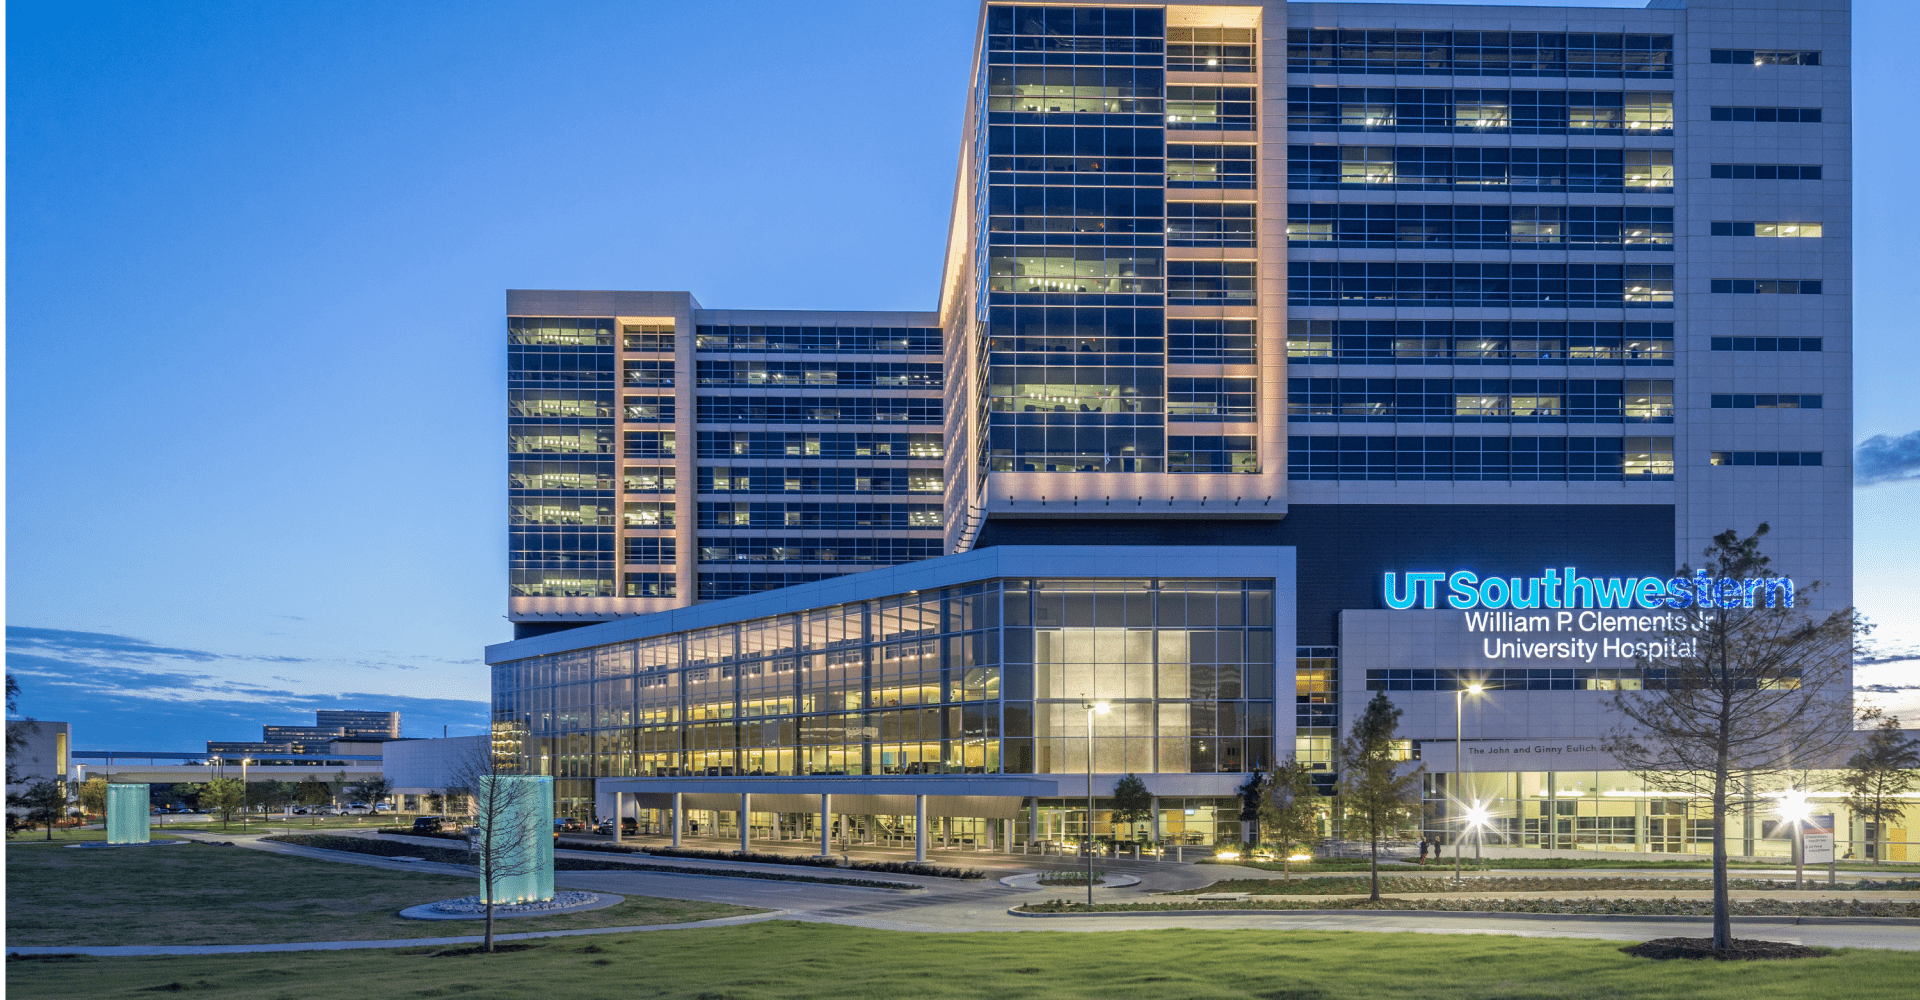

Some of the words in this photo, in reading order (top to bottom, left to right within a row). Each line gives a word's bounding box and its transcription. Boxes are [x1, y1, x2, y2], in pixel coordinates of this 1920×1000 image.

[1464, 611, 1551, 632] William
[1557, 611, 1573, 632] P.
[1577, 610, 1688, 632] Clements
[1483, 638, 1598, 663] University
[1603, 637, 1698, 662] Hospital
[1468, 747, 1485, 755] The
[1488, 746, 1510, 754] John
[1513, 745, 1531, 754] and
[1534, 745, 1563, 755] Ginny
[1566, 744, 1597, 753] Eulich
